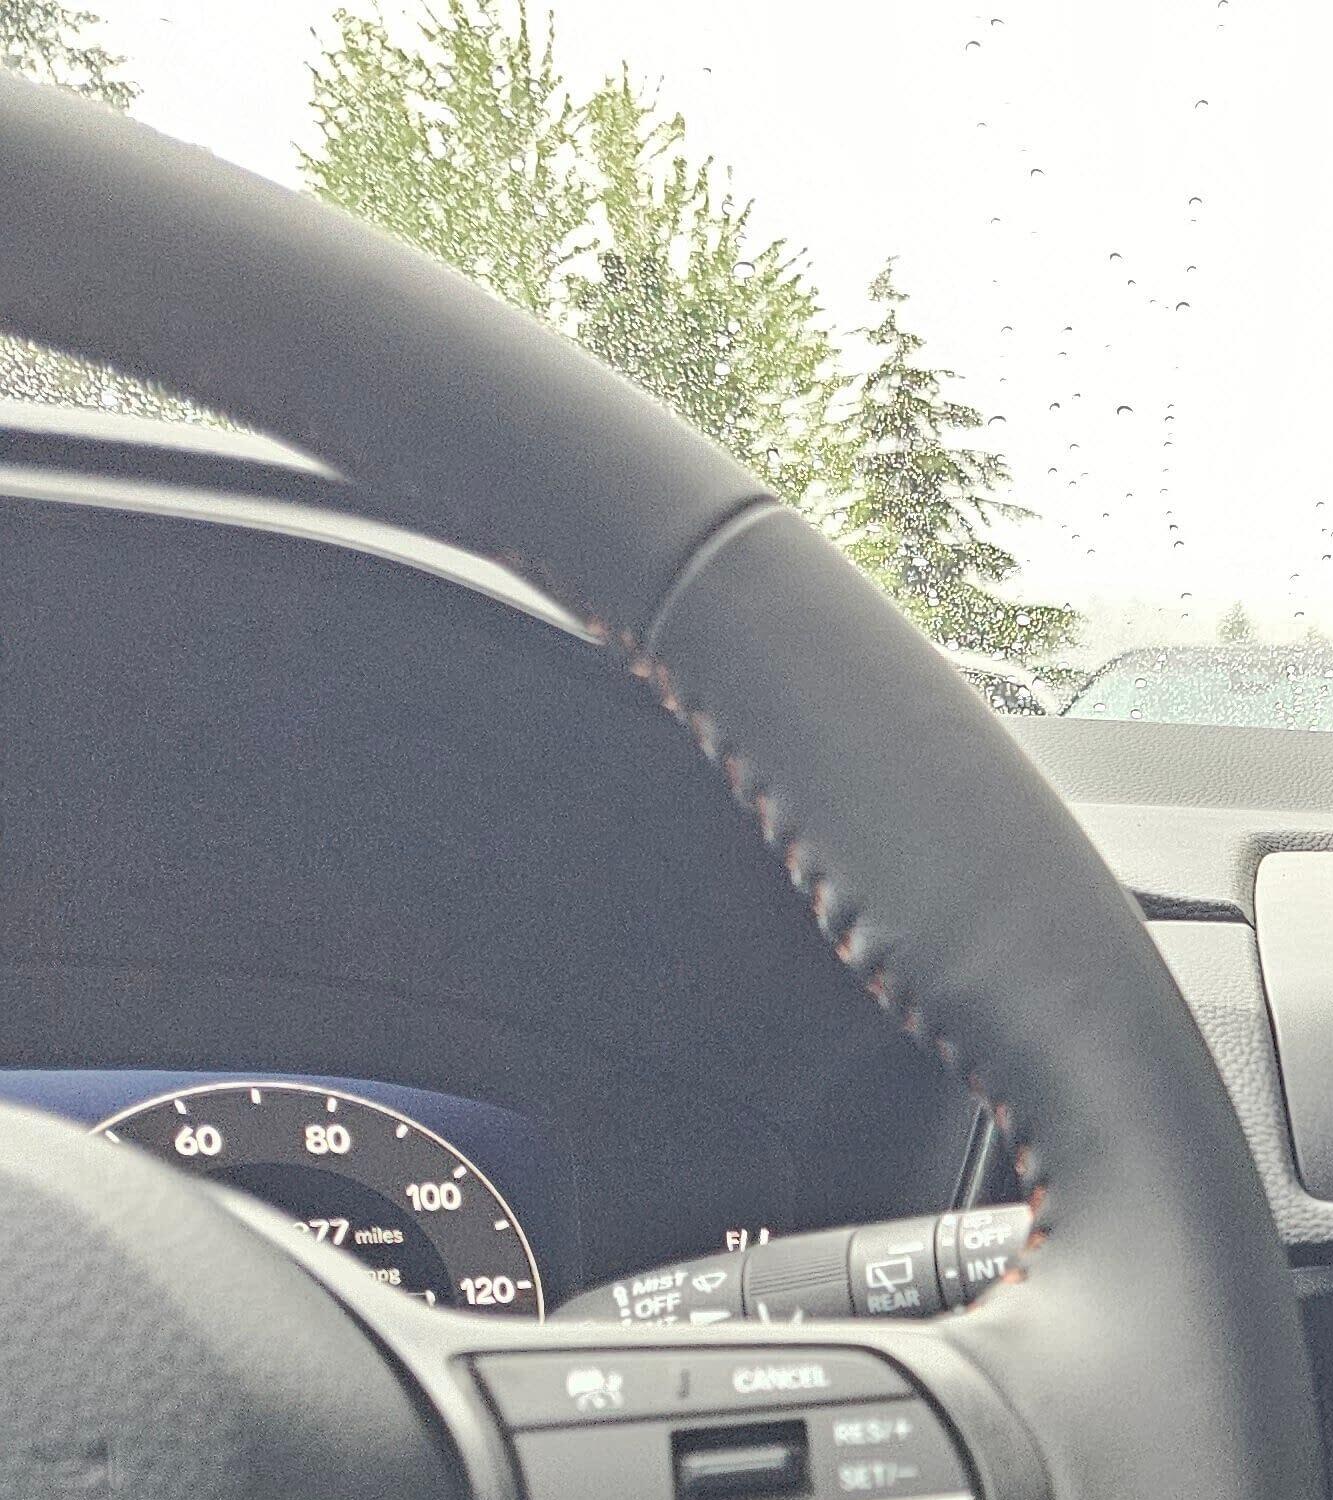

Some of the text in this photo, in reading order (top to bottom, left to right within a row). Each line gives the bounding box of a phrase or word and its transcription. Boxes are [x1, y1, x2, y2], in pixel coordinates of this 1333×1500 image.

[173, 1125, 222, 1157] 60
[305, 1124, 350, 1155] 80
[405, 1183, 462, 1212] 100
[354, 1226, 403, 1245] miles
[965, 1256, 1009, 1283] INT
[460, 1276, 515, 1306] 120
[634, 1292, 682, 1319] OFF
[867, 1289, 921, 1314] REAR
[732, 1363, 830, 1394] CANCEL
